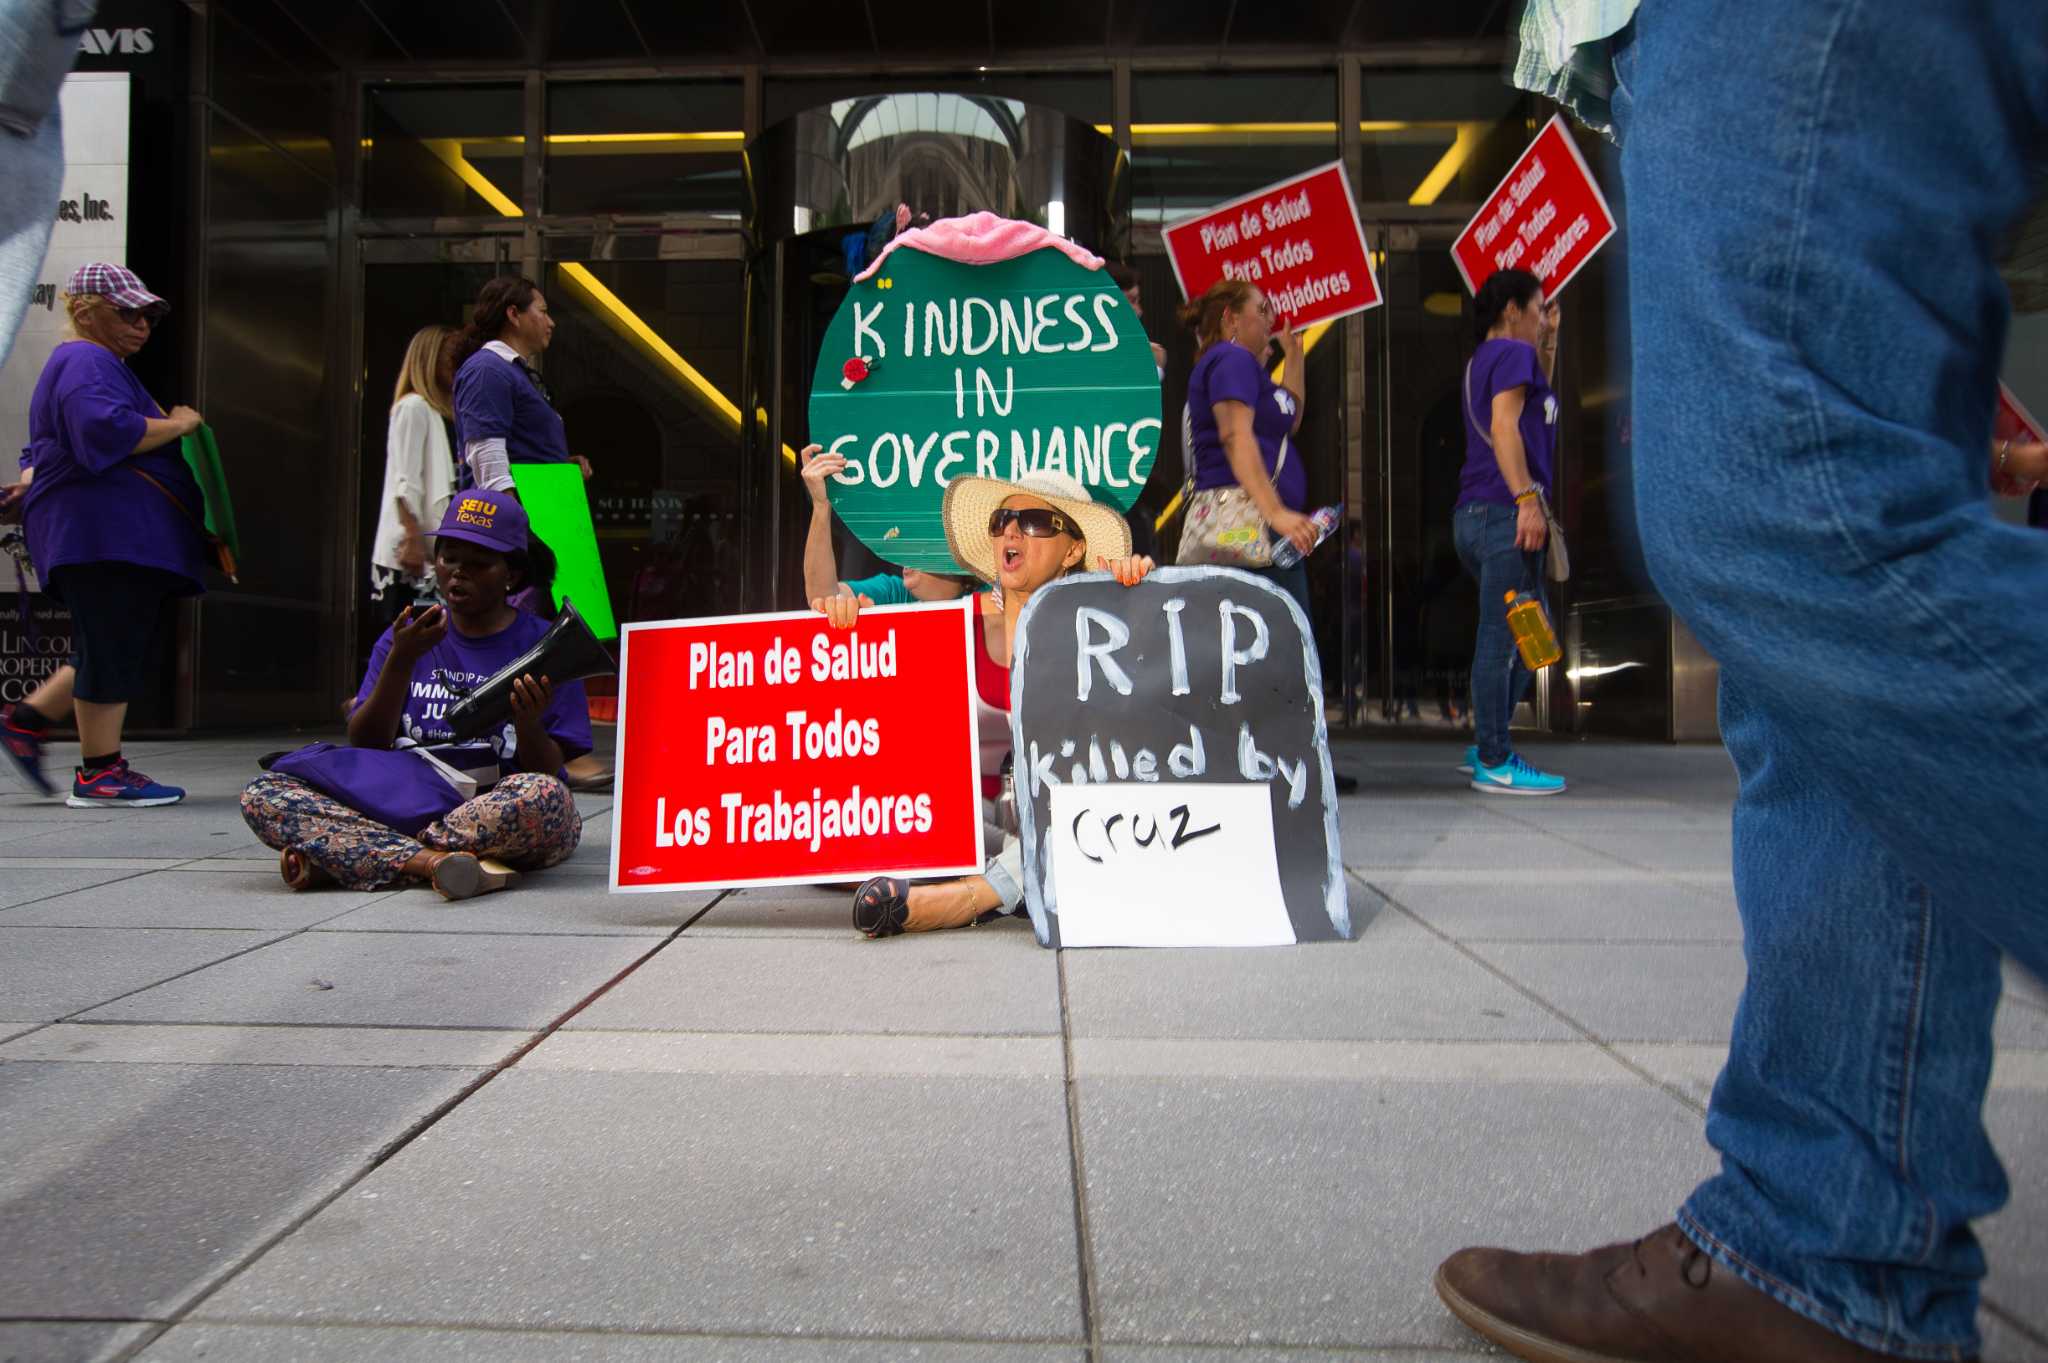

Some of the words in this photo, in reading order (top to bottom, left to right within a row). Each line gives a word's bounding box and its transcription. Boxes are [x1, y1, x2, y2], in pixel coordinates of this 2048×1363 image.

[77, 27, 155, 55] AVIS
[83, 192, 114, 221] Inc.
[1200, 221, 1239, 255] Plan
[1240, 210, 1262, 237] de
[1261, 188, 1312, 232] Salud
[1474, 214, 1501, 253] Plan
[1509, 154, 1547, 208] Salud
[1517, 199, 1557, 247] Todos
[1221, 254, 1262, 283] Para
[1261, 238, 1314, 275] Todos
[1530, 213, 1590, 281] bajadores
[1268, 270, 1351, 318] bajadores
[853, 293, 1119, 359] KINDNESS
[954, 366, 1014, 418] IN
[829, 417, 1162, 489] GOVERNANCE
[456, 510, 494, 529] Texas
[459, 498, 497, 516] SEIU
[0, 655, 69, 676] OPERT
[2, 630, 77, 654] LINCOL
[688, 640, 755, 690] Plan
[764, 636, 801, 686] de
[811, 628, 898, 683] Salud
[706, 716, 776, 766] Para
[786, 708, 880, 761] Todos
[1238, 721, 1308, 811] by
[655, 796, 711, 848] Los
[720, 785, 933, 853] Trabajadores
